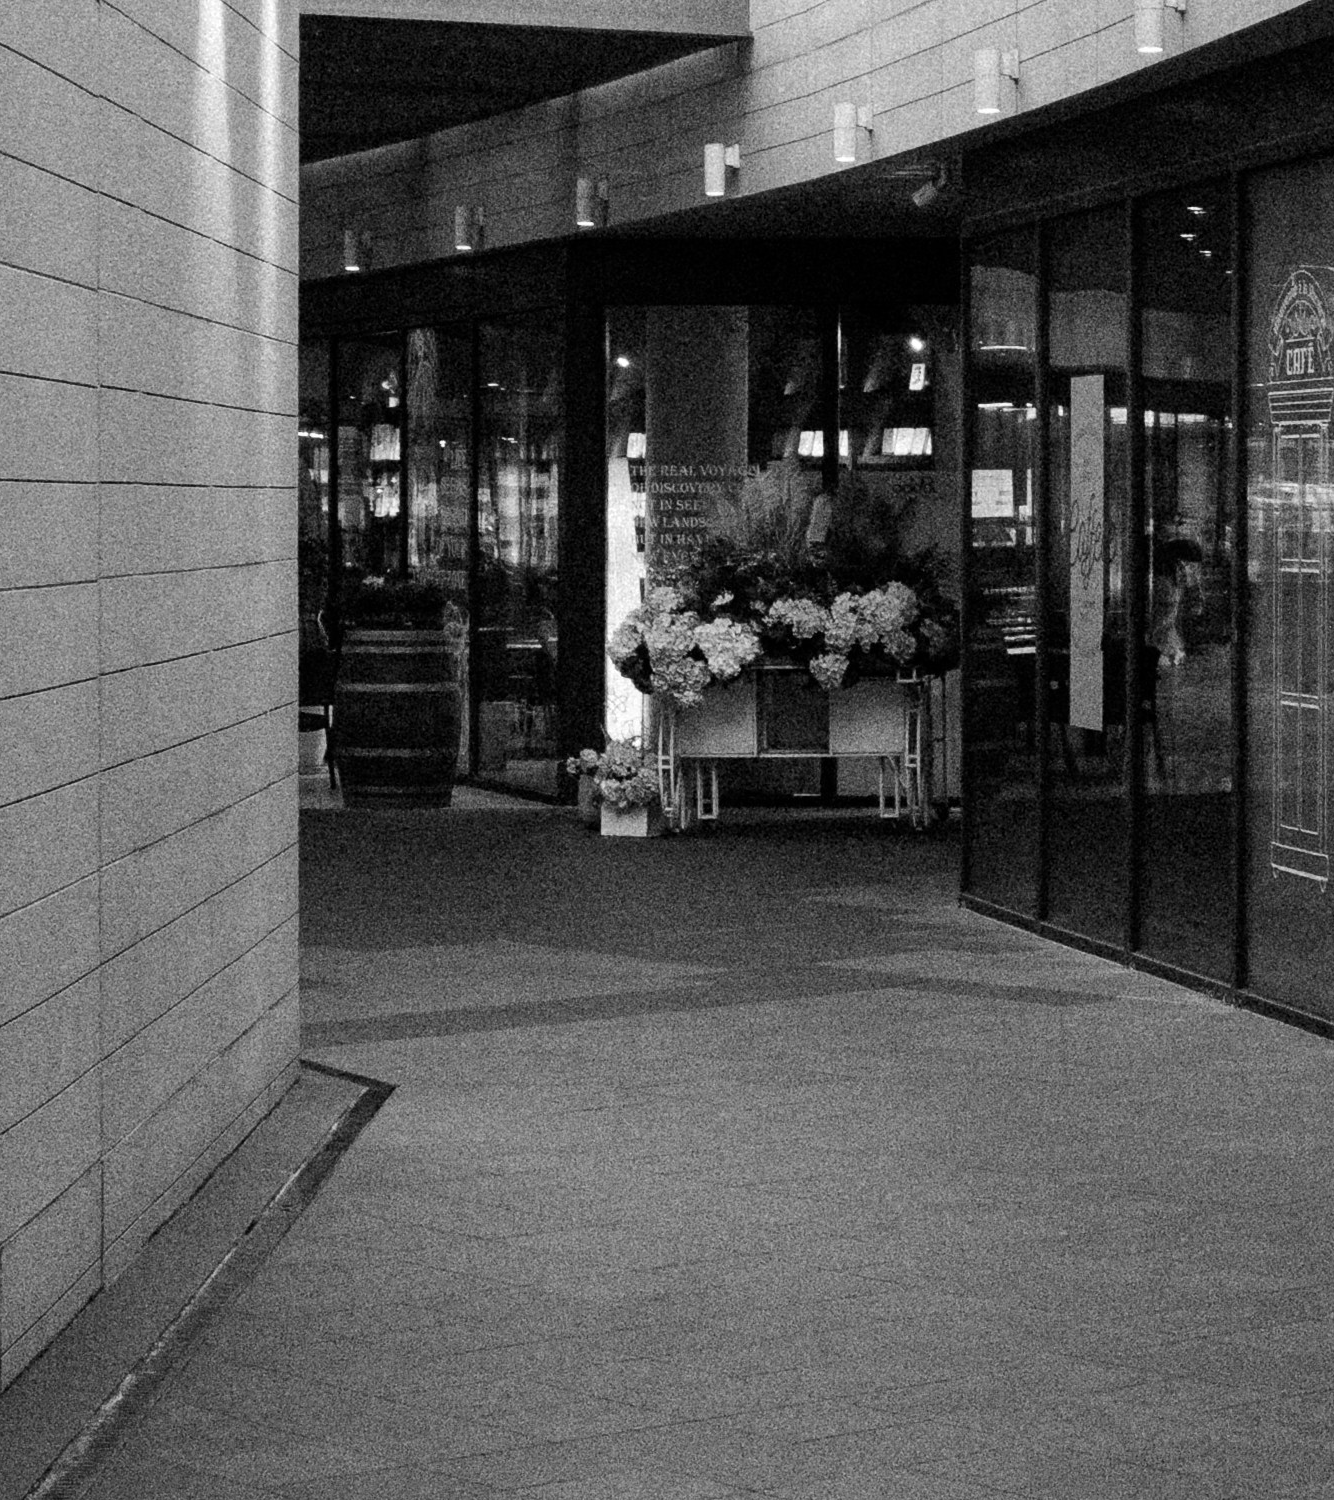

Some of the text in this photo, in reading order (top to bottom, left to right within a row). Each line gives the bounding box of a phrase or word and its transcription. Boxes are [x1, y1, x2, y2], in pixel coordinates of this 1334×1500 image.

[1286, 341, 1315, 375] CAFÉ
[630, 465, 656, 477] THE
[660, 465, 696, 477] REAL
[660, 500, 673, 511] IN
[660, 534, 673, 545] IN
